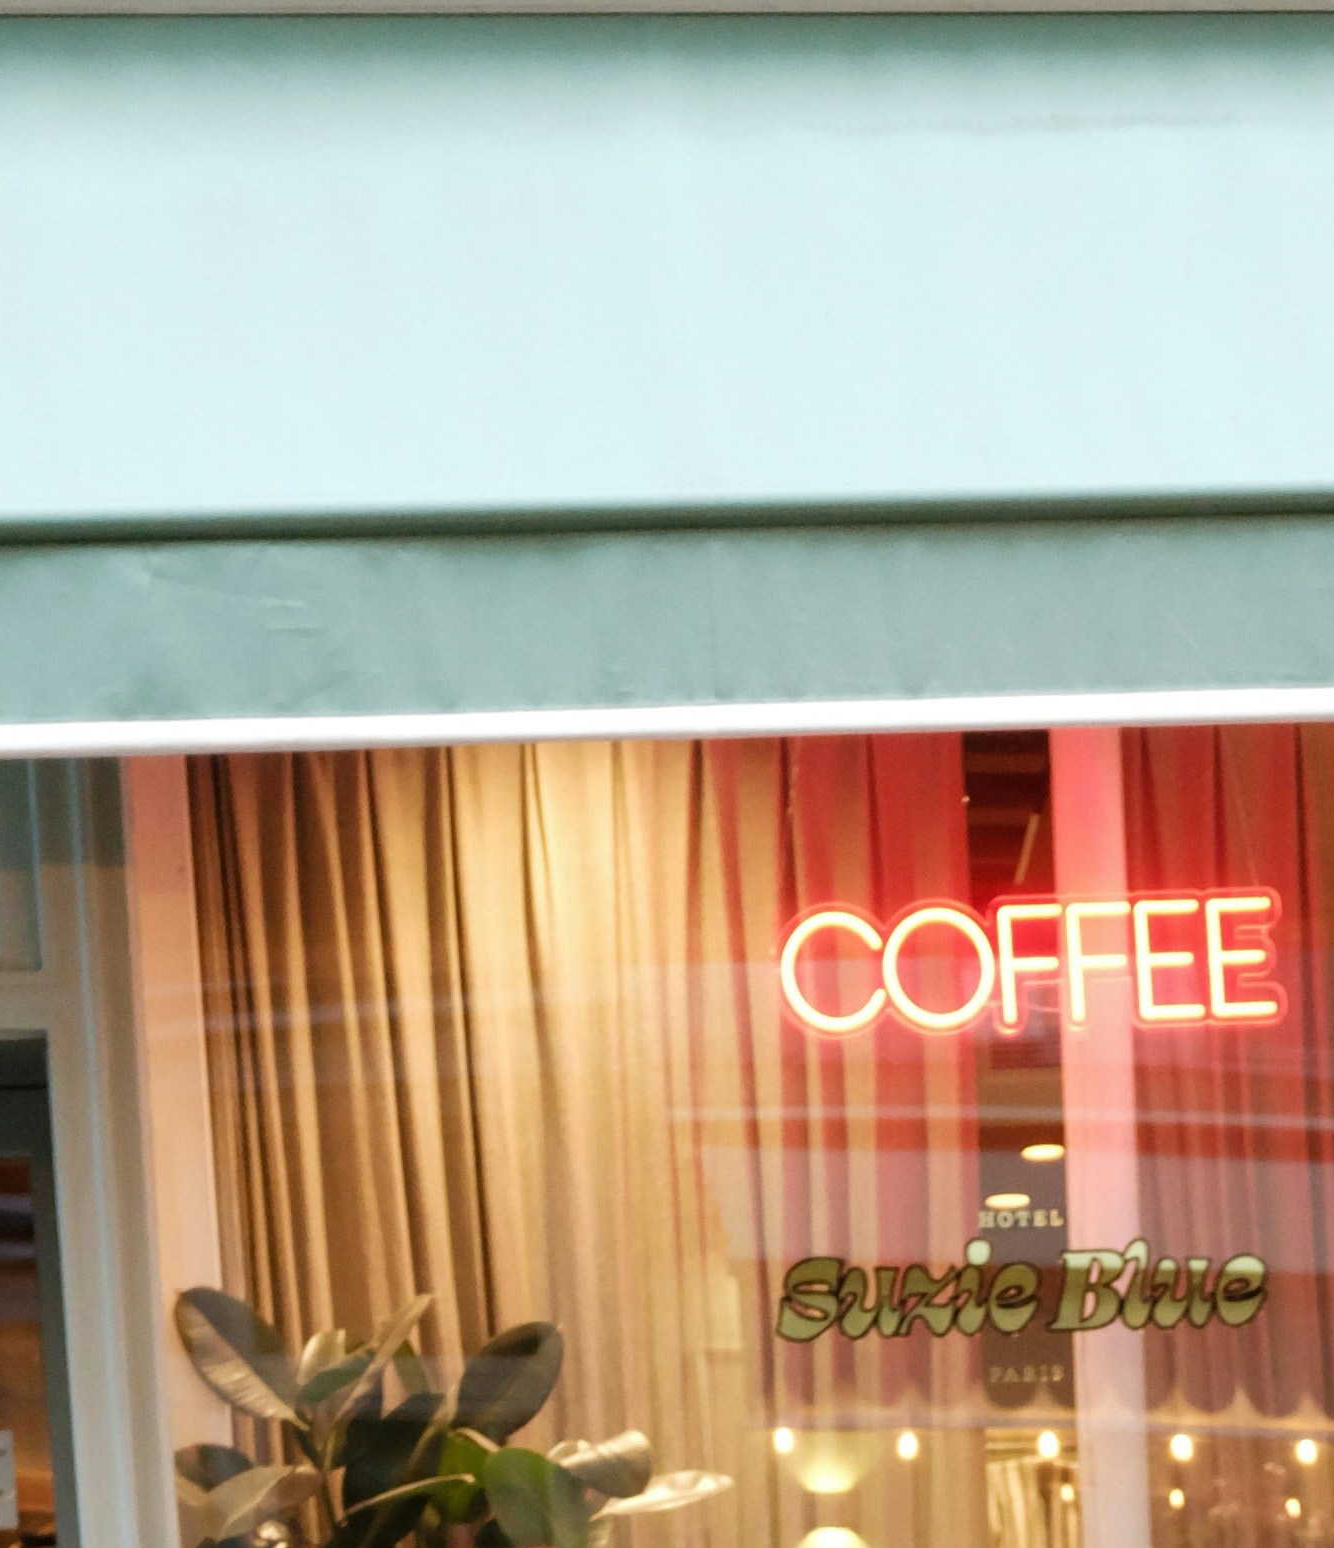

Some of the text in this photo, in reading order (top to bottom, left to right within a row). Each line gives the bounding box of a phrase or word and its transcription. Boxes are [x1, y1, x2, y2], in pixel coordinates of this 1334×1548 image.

[777, 892, 1283, 1035] COFFEE
[977, 1208, 1065, 1228] HOTEL
[776, 1236, 1269, 1344] Suzie Blue
[988, 1364, 1064, 1383] PARIS
